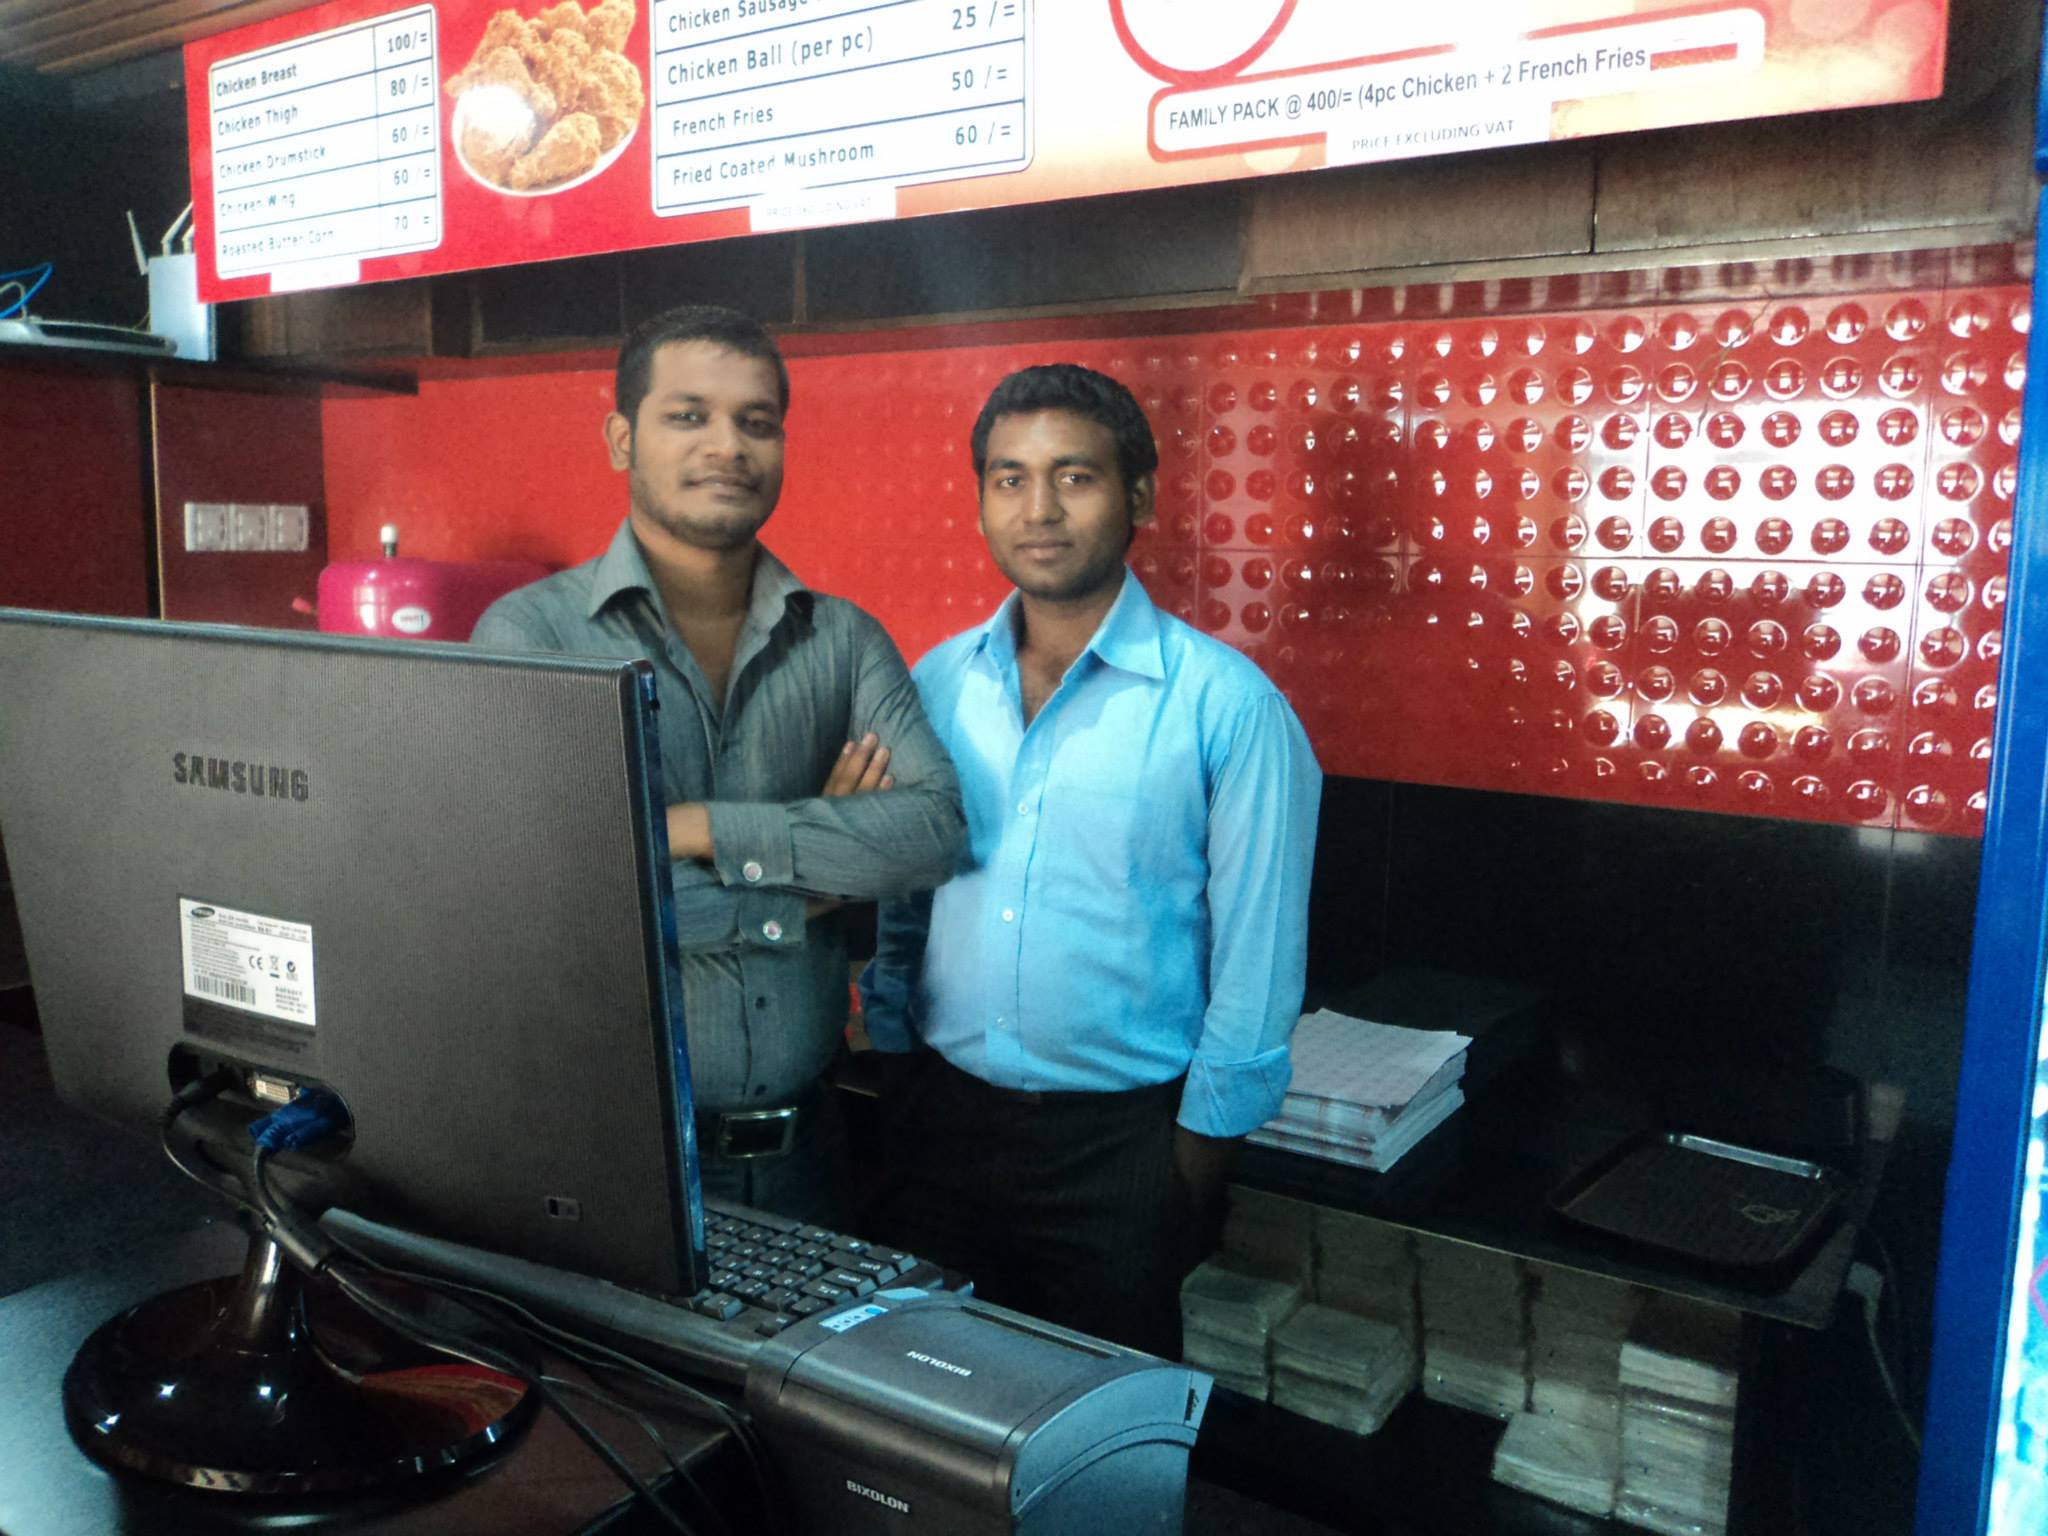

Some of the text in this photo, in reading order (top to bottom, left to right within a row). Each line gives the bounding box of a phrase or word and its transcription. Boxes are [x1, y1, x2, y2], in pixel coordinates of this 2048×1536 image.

[669, 7, 730, 32] Chicken
[952, 5, 977, 30] 25
[388, 31, 428, 53] 100/=
[668, 26, 873, 85] Chicken Ball (per pc)
[216, 64, 297, 97] Chicken Breast
[390, 77, 407, 97] 80
[951, 68, 974, 91] 50
[1169, 47, 1646, 130] FAMILY PACK @ 400/= (4pc Chicken + 2 French Fries
[218, 105, 298, 136] Chicken Thigh
[673, 105, 773, 136] French Fries
[955, 124, 978, 146] 60
[1352, 119, 1515, 150] PRICE EXCLUDING VAT
[219, 145, 326, 179] Chicken Drumstick
[673, 142, 874, 186] Fried Coated Mushroom
[173, 752, 309, 802] SAMSUNG
[905, 1350, 974, 1377] BIXOLON
[845, 1480, 911, 1514] BIXOLON
